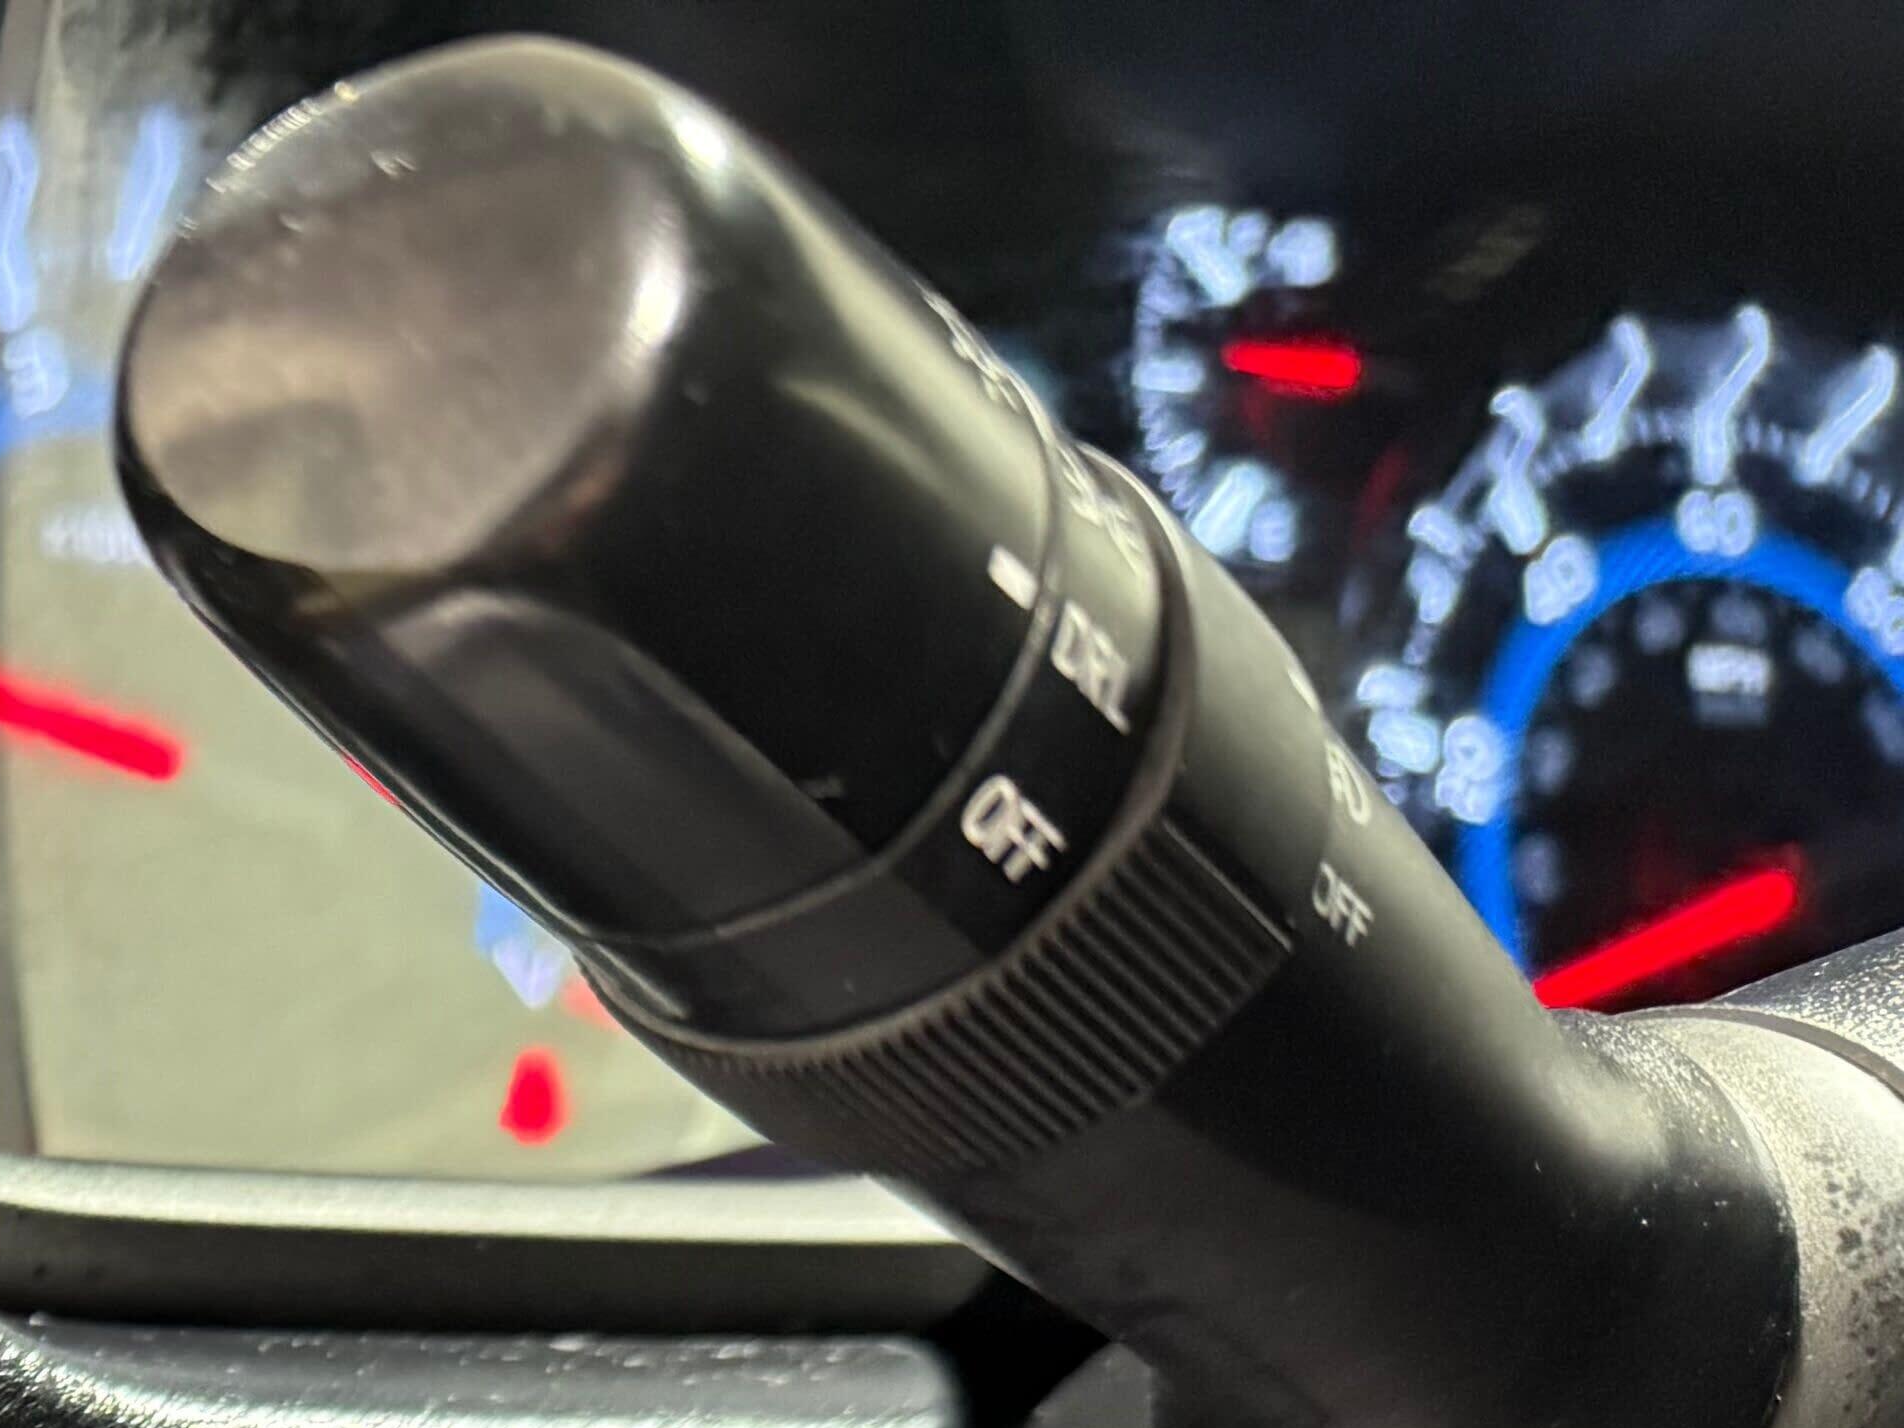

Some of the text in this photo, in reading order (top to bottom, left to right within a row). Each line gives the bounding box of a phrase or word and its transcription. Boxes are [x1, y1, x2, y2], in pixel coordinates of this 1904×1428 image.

[1675, 488, 1758, 558] 60
[959, 773, 1068, 884] OFF
[1312, 860, 1375, 948] OFF
